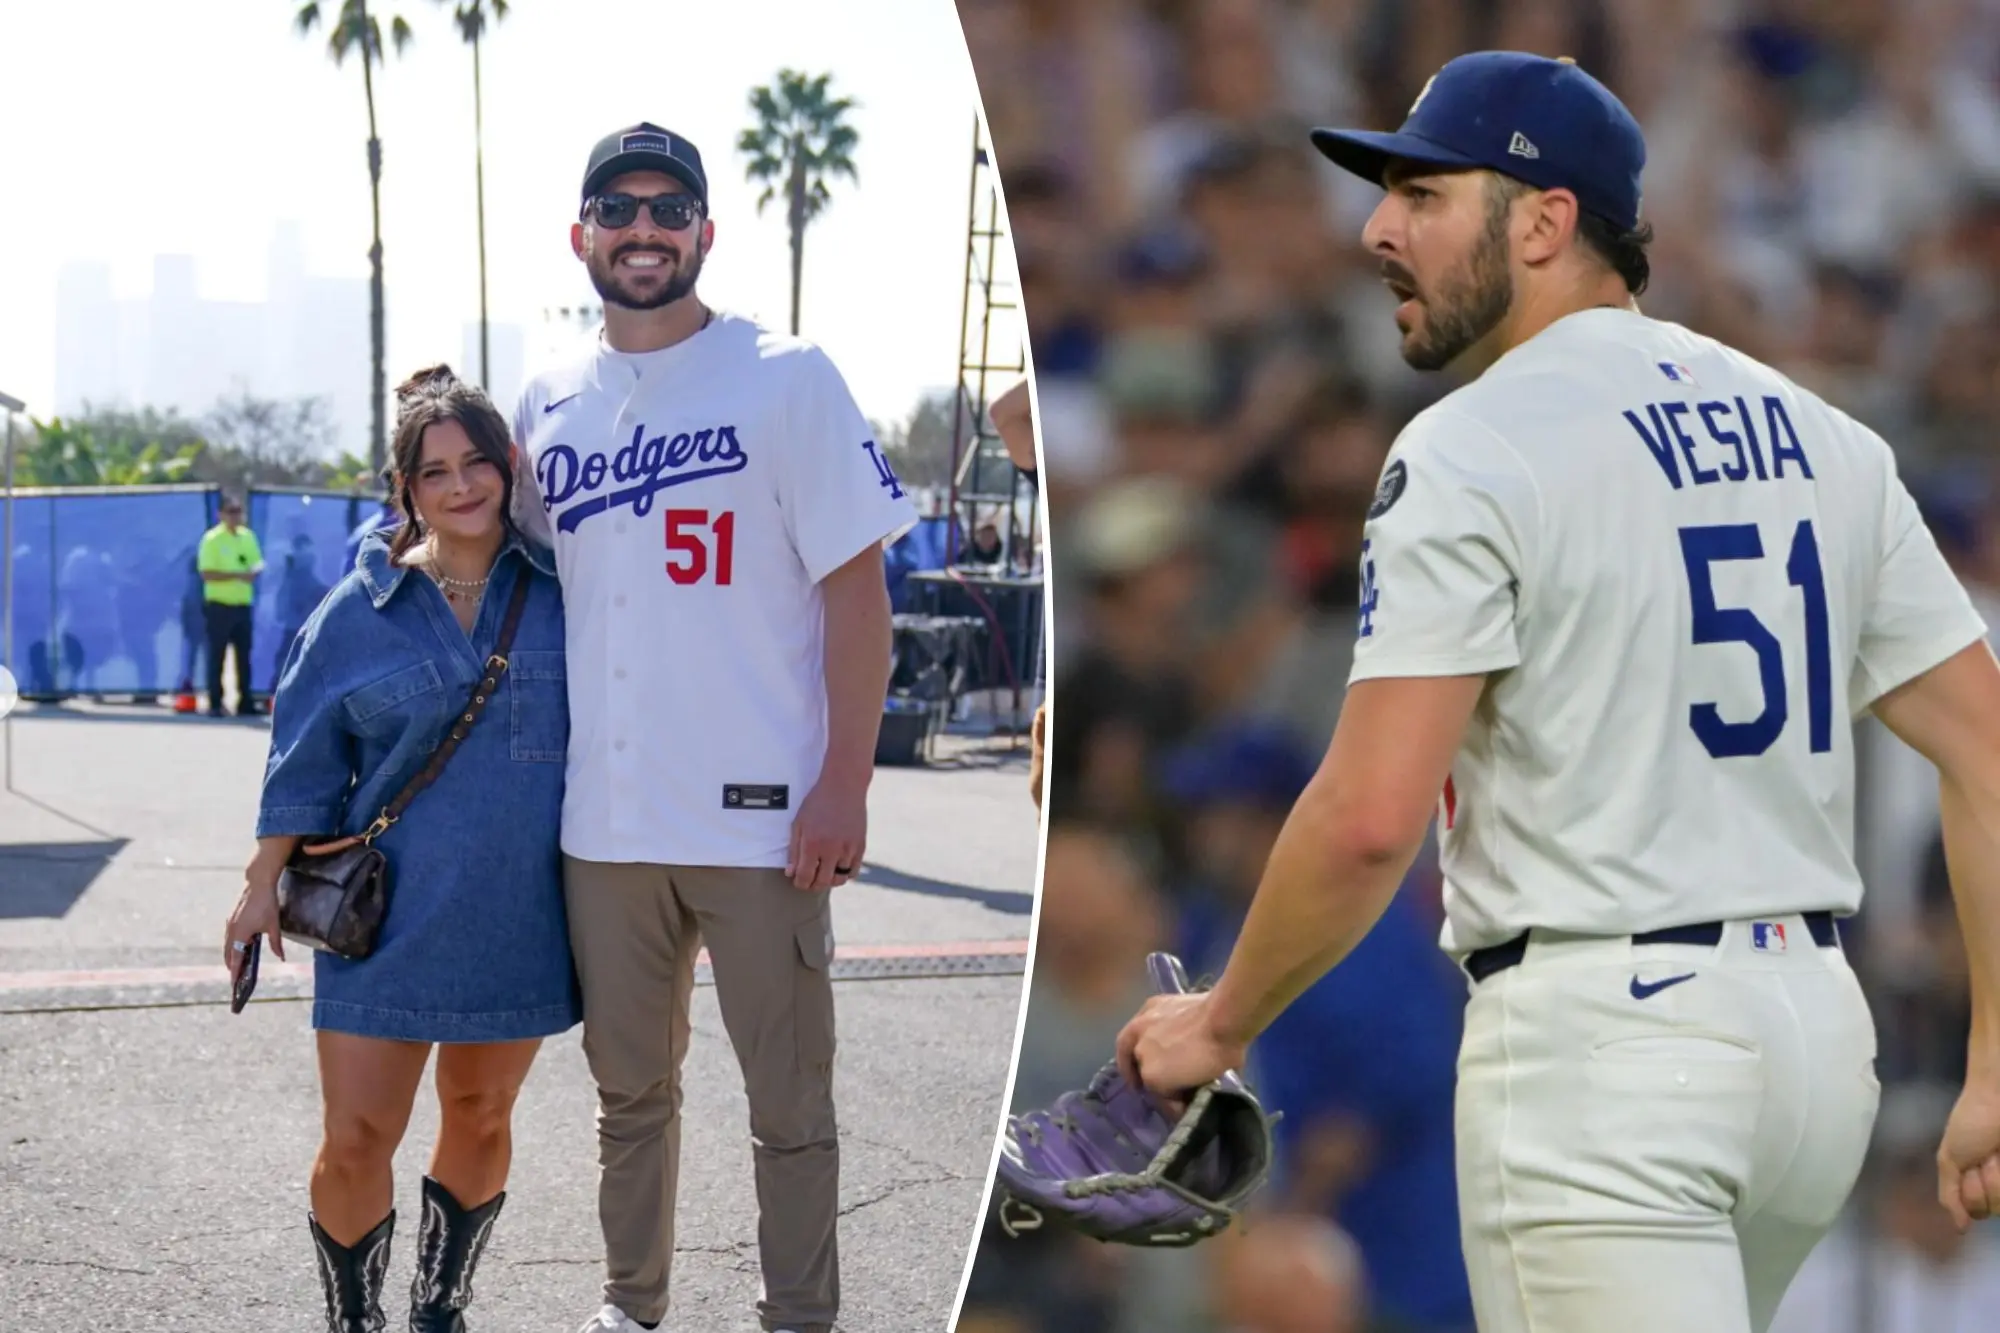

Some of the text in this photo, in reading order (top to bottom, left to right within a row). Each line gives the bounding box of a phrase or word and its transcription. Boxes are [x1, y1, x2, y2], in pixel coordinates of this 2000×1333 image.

[537, 424, 748, 534] Dodgers
[1622, 395, 1815, 490] VESIA
[665, 509, 734, 586] 51
[1678, 519, 1832, 759] 51
